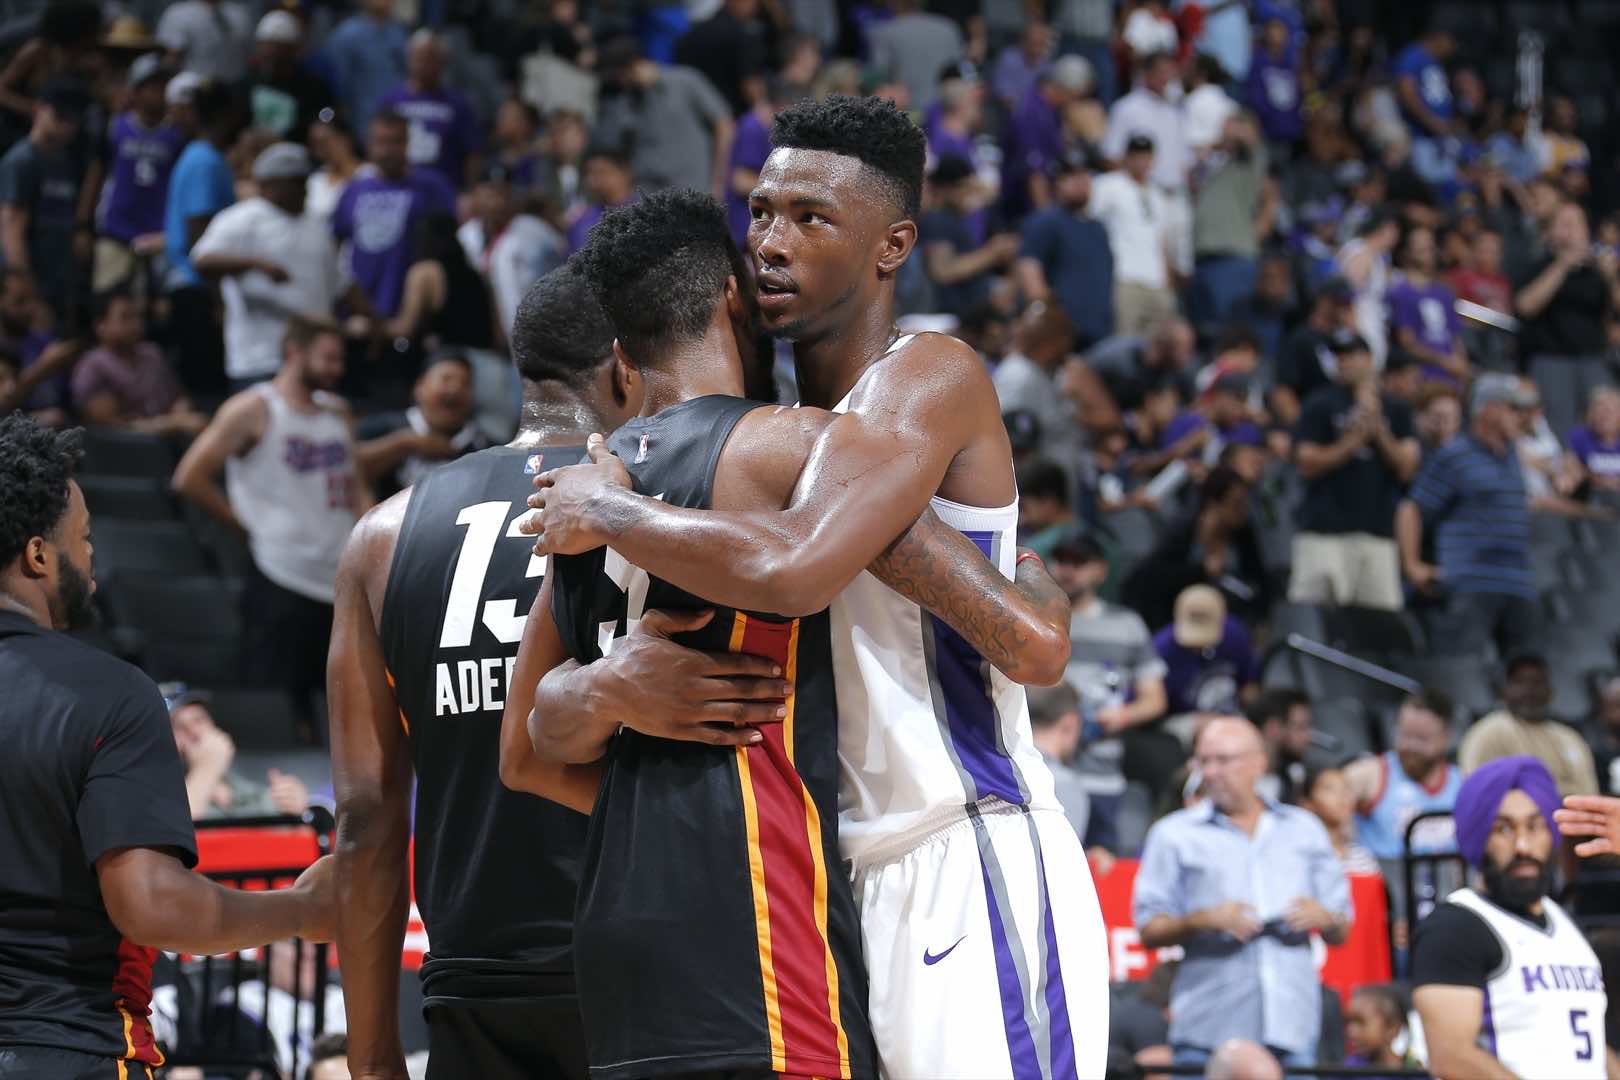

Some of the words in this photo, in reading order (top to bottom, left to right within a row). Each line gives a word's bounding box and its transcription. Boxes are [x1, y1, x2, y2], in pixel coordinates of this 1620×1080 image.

[439, 500, 549, 648] 13
[436, 656, 517, 716] ADE
[1569, 1009, 1592, 1060] 5
